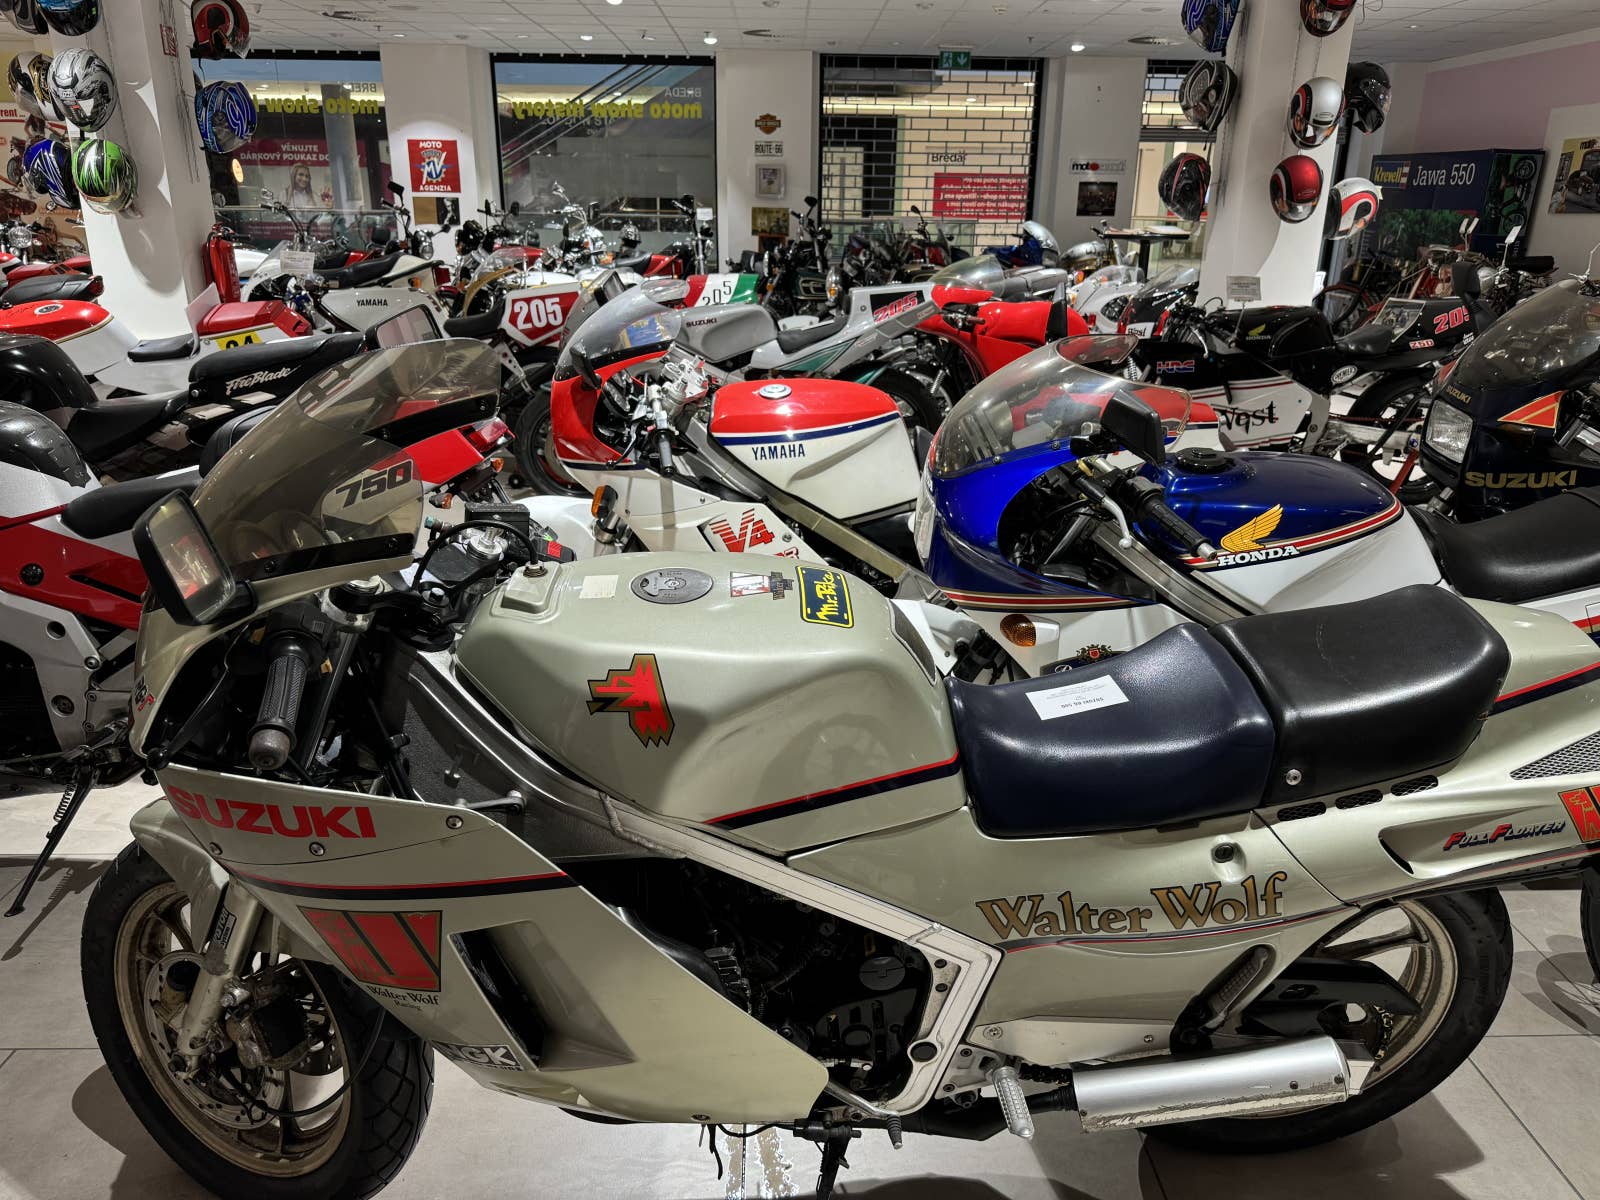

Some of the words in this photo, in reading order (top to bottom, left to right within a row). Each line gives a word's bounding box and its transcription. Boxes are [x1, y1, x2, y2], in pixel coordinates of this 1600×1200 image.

[419, 141, 443, 149] MOTO
[755, 144, 772, 153] ROUTE
[775, 144, 783, 153] 66
[282, 153, 318, 161] POUKAZ
[1412, 166, 1446, 186] Jawa
[1450, 162, 1476, 185] 550
[356, 298, 388, 307] YAMAHA
[703, 280, 731, 305] 205
[514, 297, 563, 330] 205
[873, 291, 918, 323] 205
[685, 317, 718, 328] SUZUKI
[1156, 360, 1195, 373] HRC
[1445, 385, 1473, 403] SUZUKI
[752, 443, 805, 460] YAMAHA
[335, 460, 412, 508] 750
[1465, 469, 1578, 489] SUZUKI
[709, 508, 775, 552] V4
[1217, 545, 1300, 567] HONDA
[166, 784, 376, 839] SUZUKI
[976, 890, 1152, 940] Walter
[1151, 871, 1287, 930] Wolf
[366, 985, 407, 1001] Walter
[406, 992, 440, 1006] Wolf
